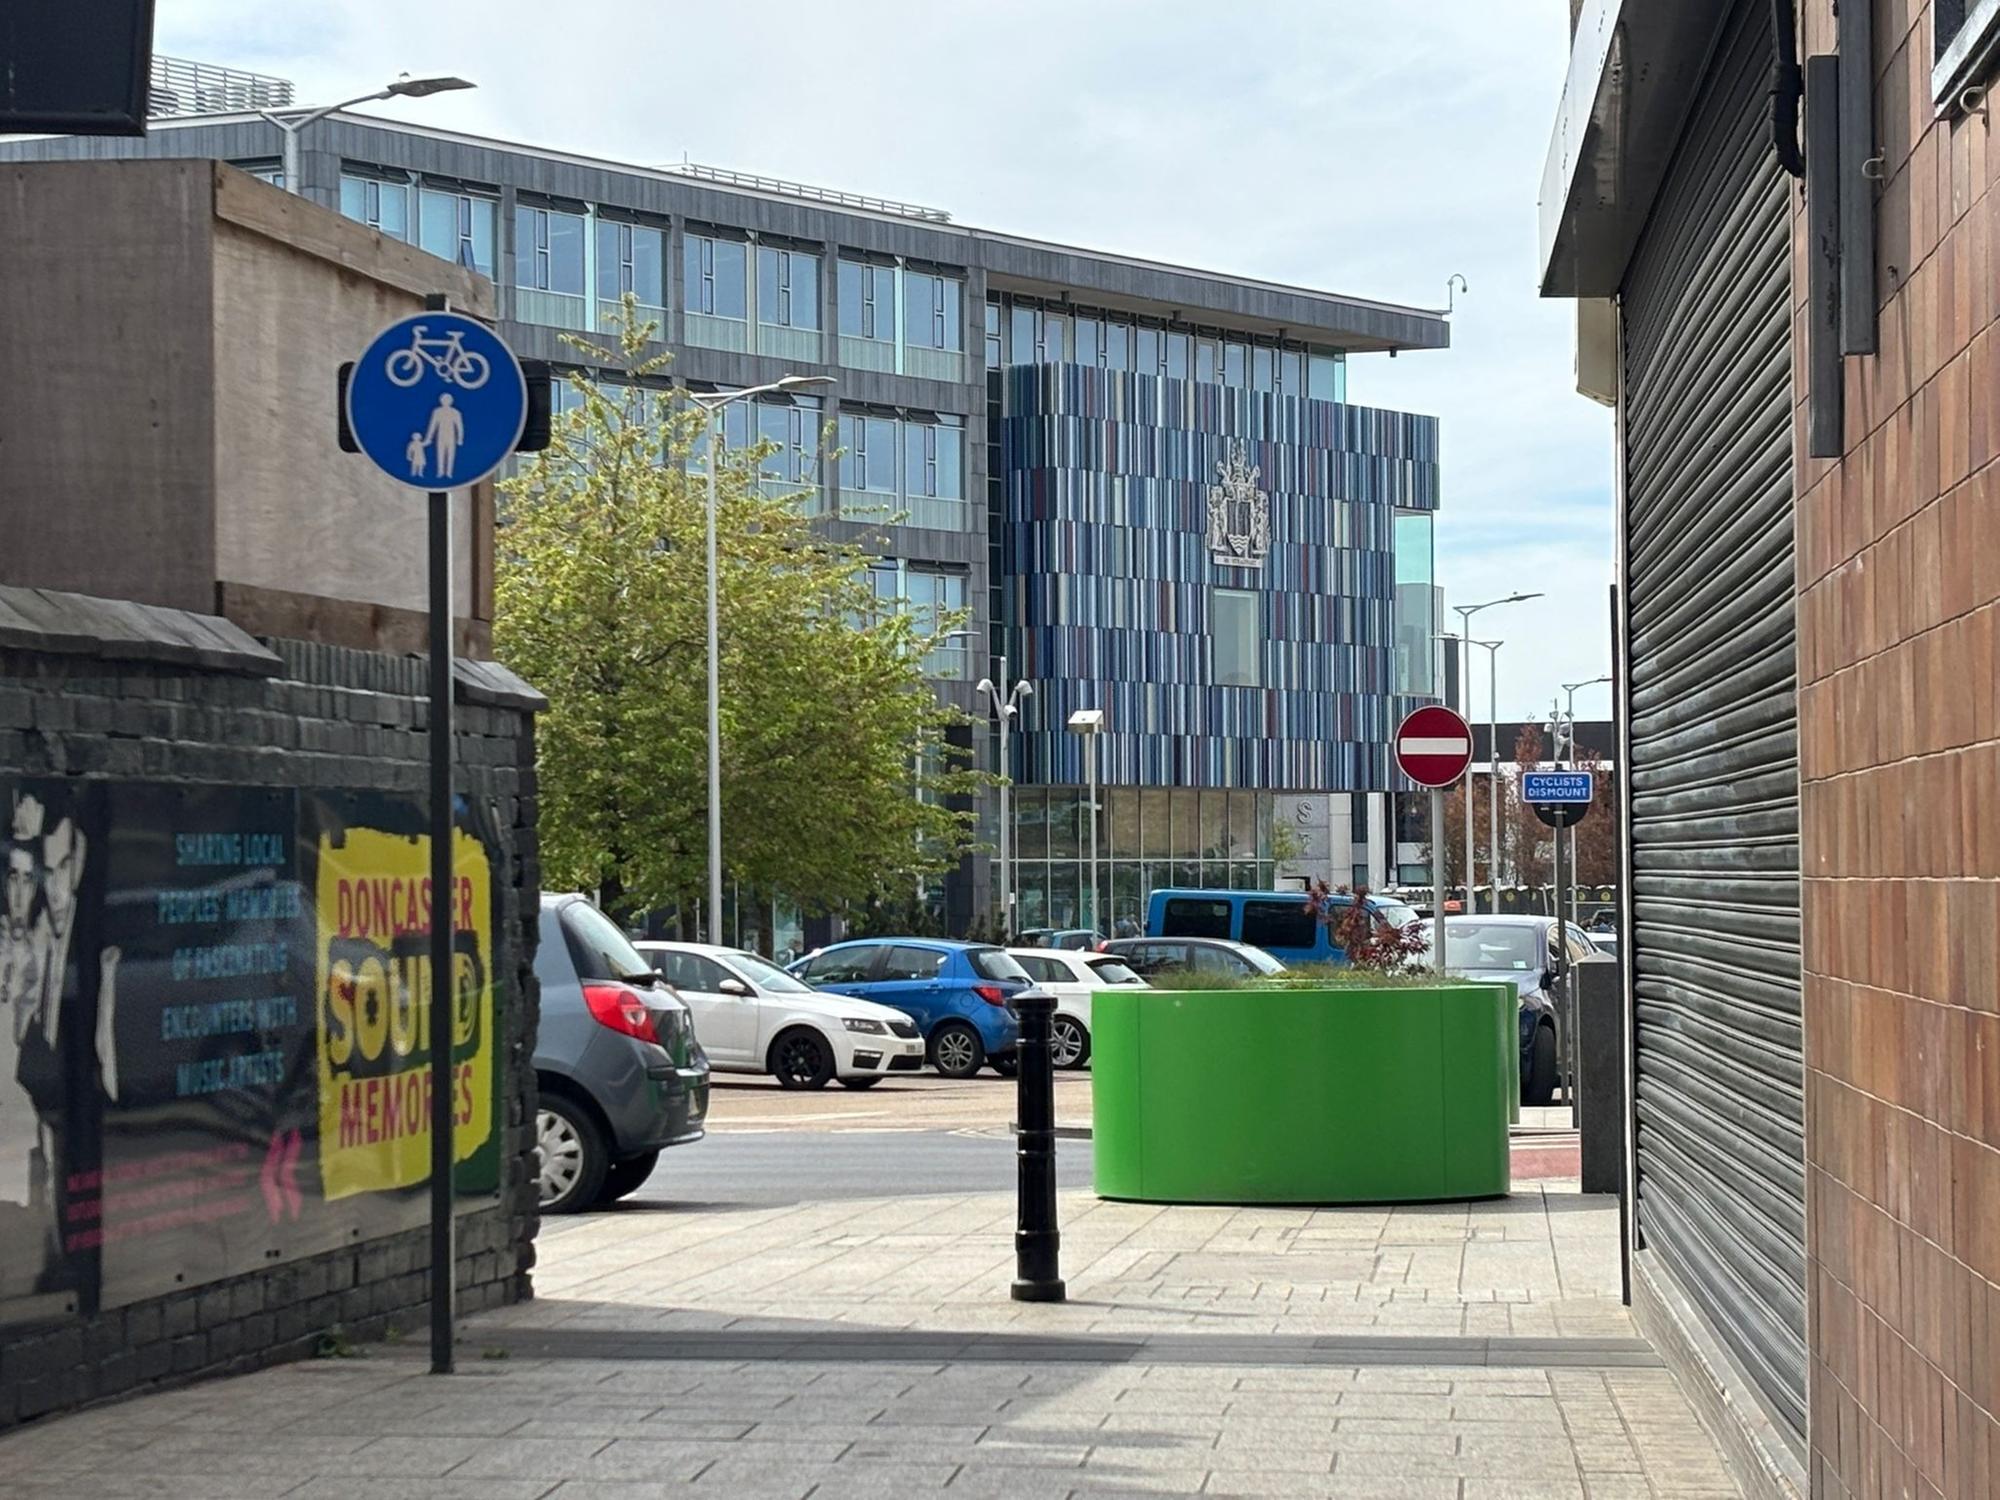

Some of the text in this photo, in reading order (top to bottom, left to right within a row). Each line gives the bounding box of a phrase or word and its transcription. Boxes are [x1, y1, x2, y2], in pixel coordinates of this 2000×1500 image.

[1528, 787, 1588, 797] DISMOUNT
[1531, 776, 1584, 787] CYCLISTS
[244, 833, 286, 865] LOCAL
[338, 876, 473, 939] DONCASER
[340, 1063, 473, 1149] MEMORES
